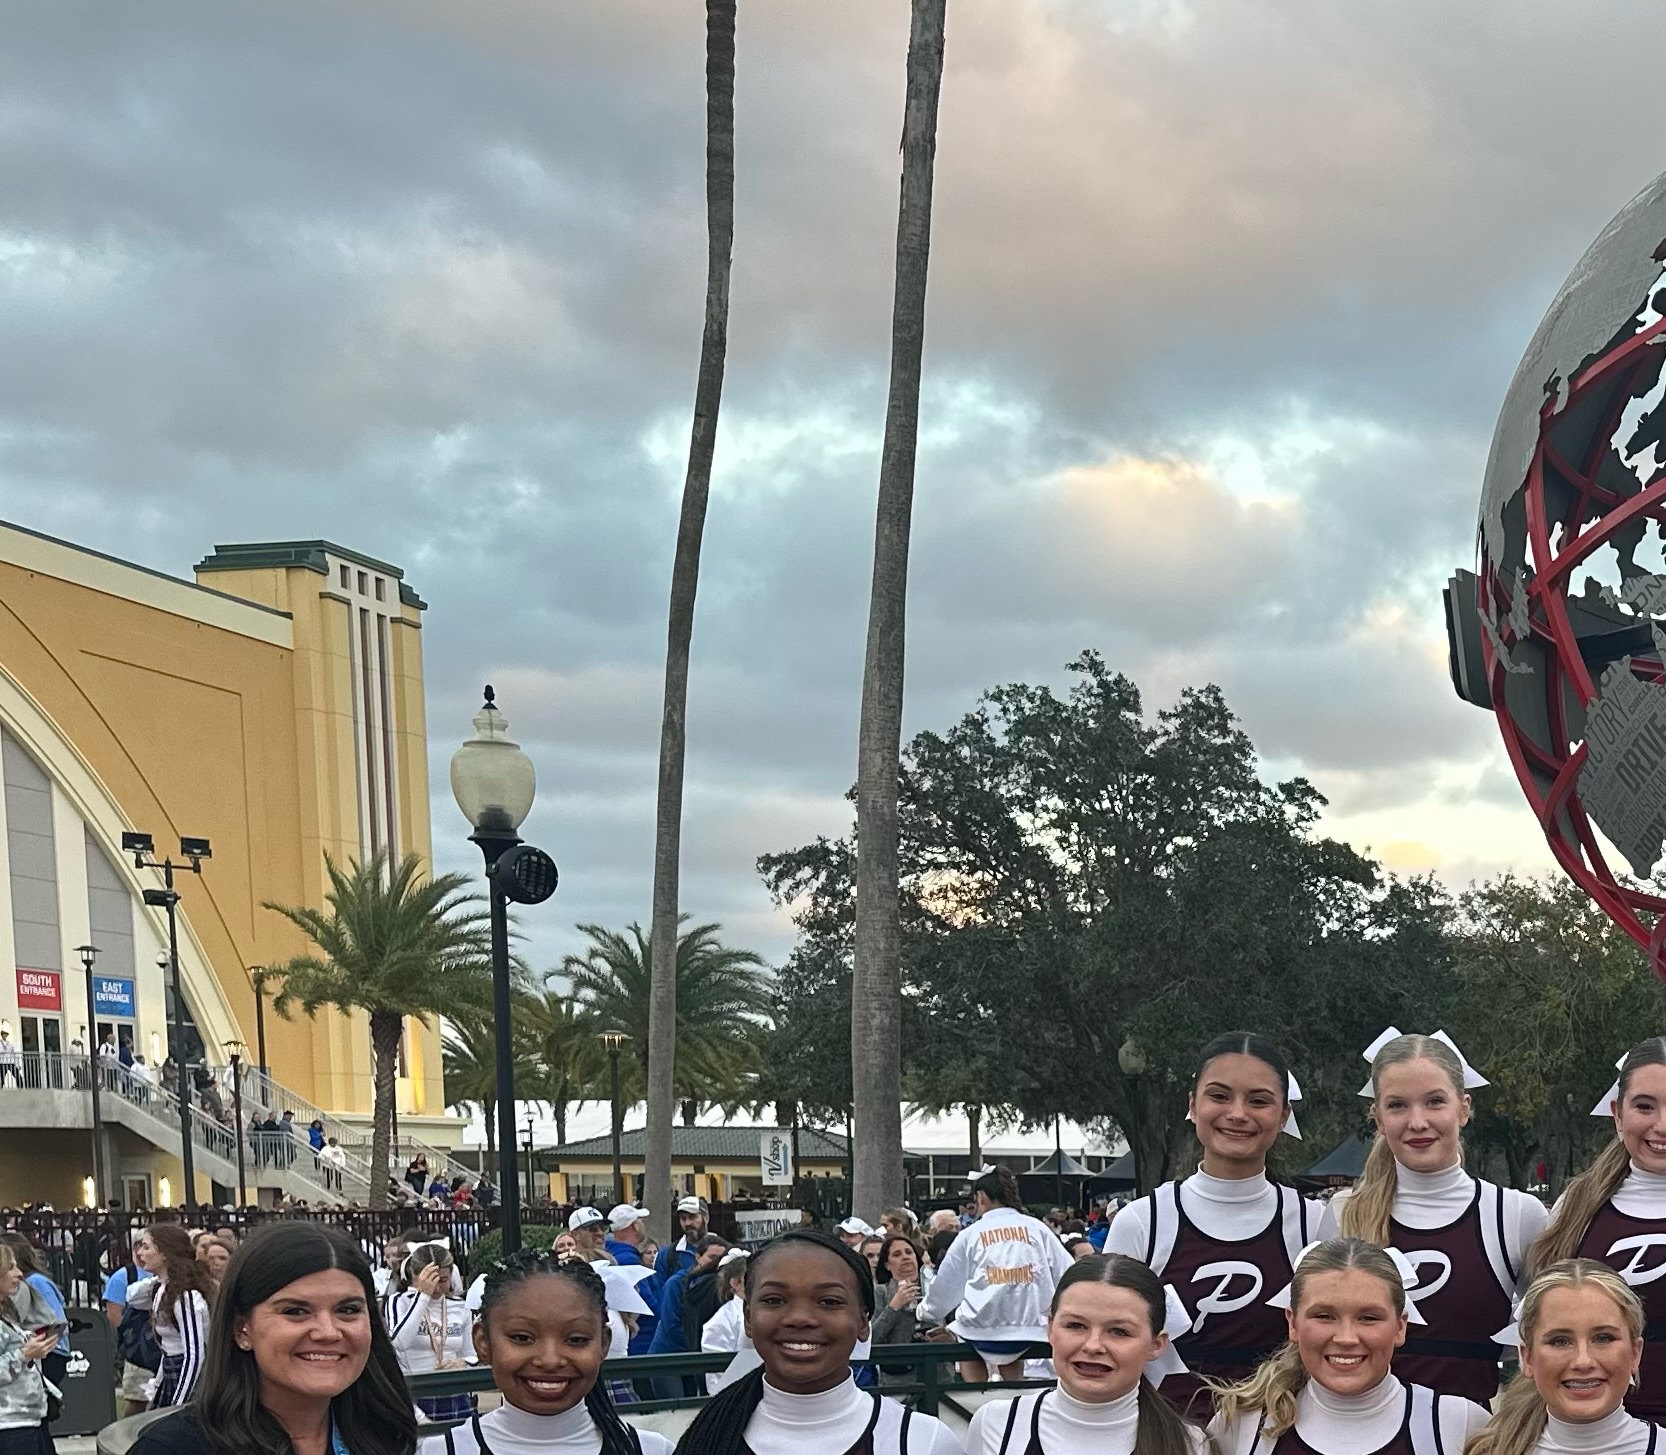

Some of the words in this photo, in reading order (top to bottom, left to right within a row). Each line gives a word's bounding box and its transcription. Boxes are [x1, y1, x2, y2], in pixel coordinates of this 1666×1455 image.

[22, 973, 52, 987] SOUTH
[102, 981, 123, 993] EAST
[980, 1226, 1032, 1249] NATIONAL
